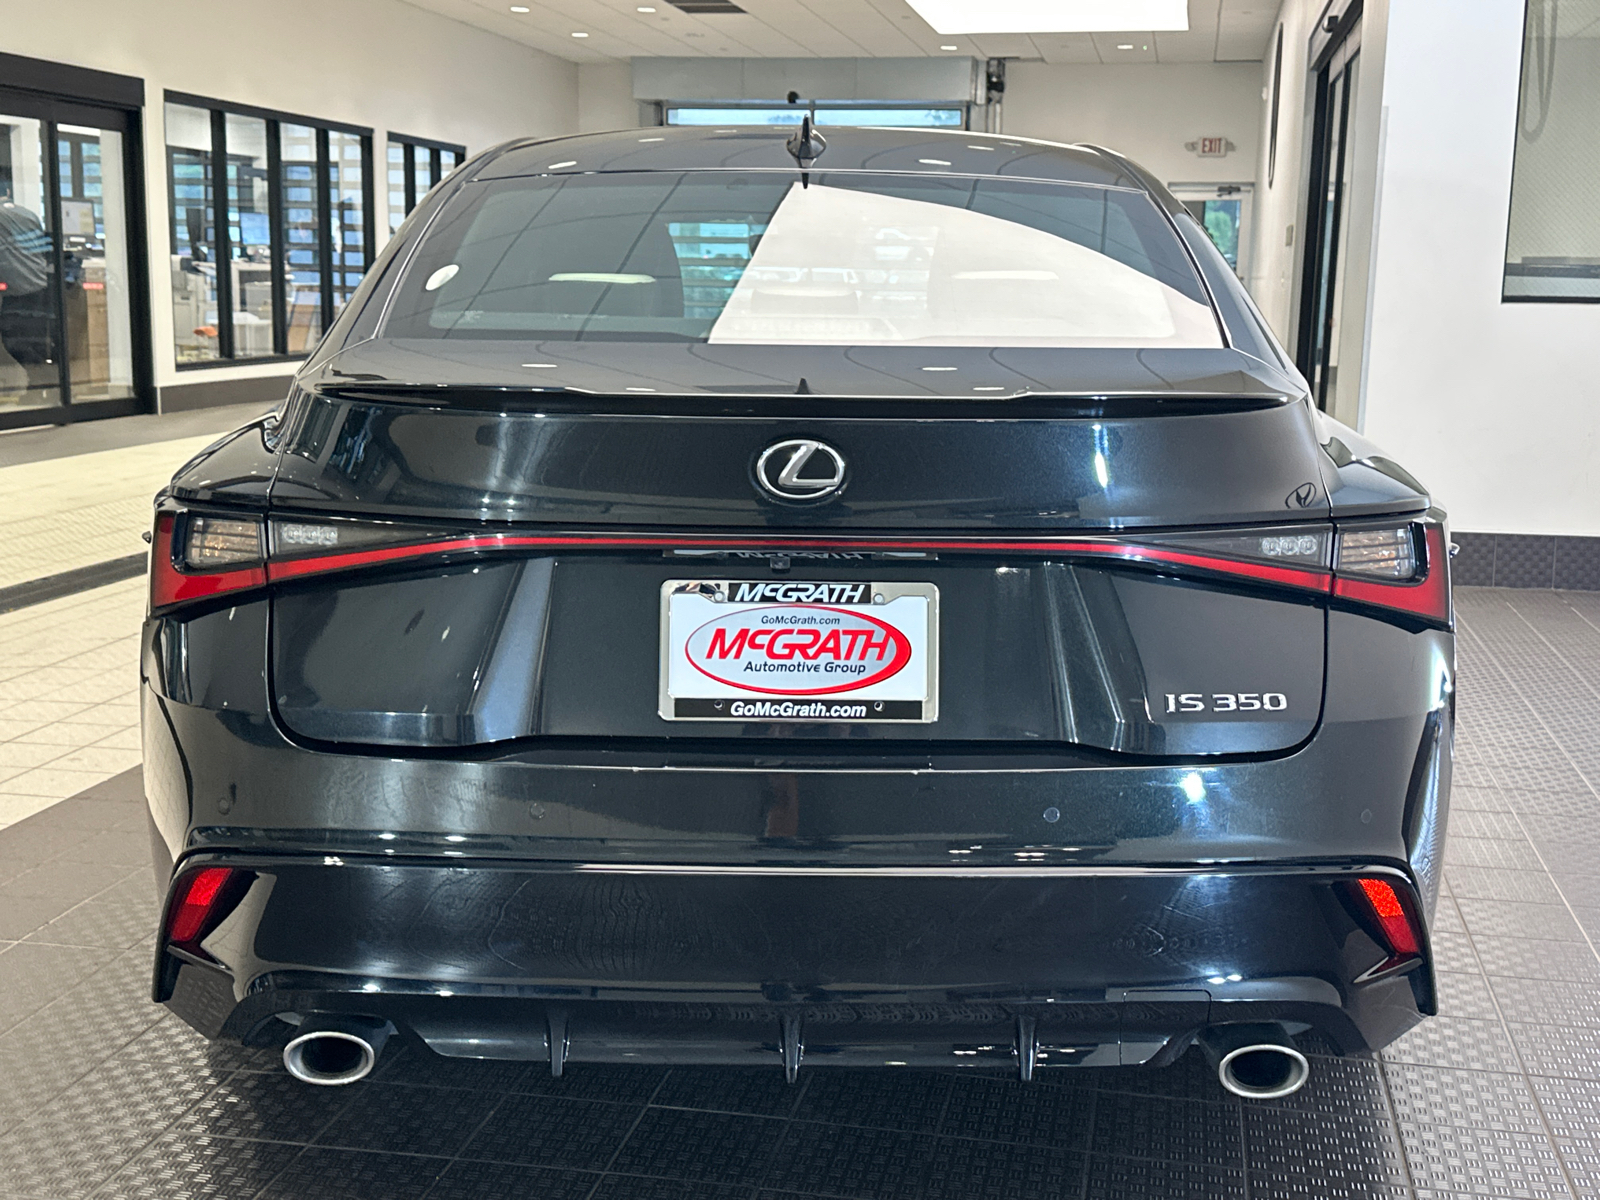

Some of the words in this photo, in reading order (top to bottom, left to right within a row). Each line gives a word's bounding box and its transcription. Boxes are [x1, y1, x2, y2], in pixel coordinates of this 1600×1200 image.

[1202, 138, 1222, 153] EXIT
[761, 615, 840, 625] GoMcGrath.com
[743, 661, 820, 673] Automotive
[824, 661, 866, 676] Group
[730, 701, 867, 718] GoMcGrath.com
[1165, 693, 1205, 713] IS
[1212, 692, 1288, 712] 350
